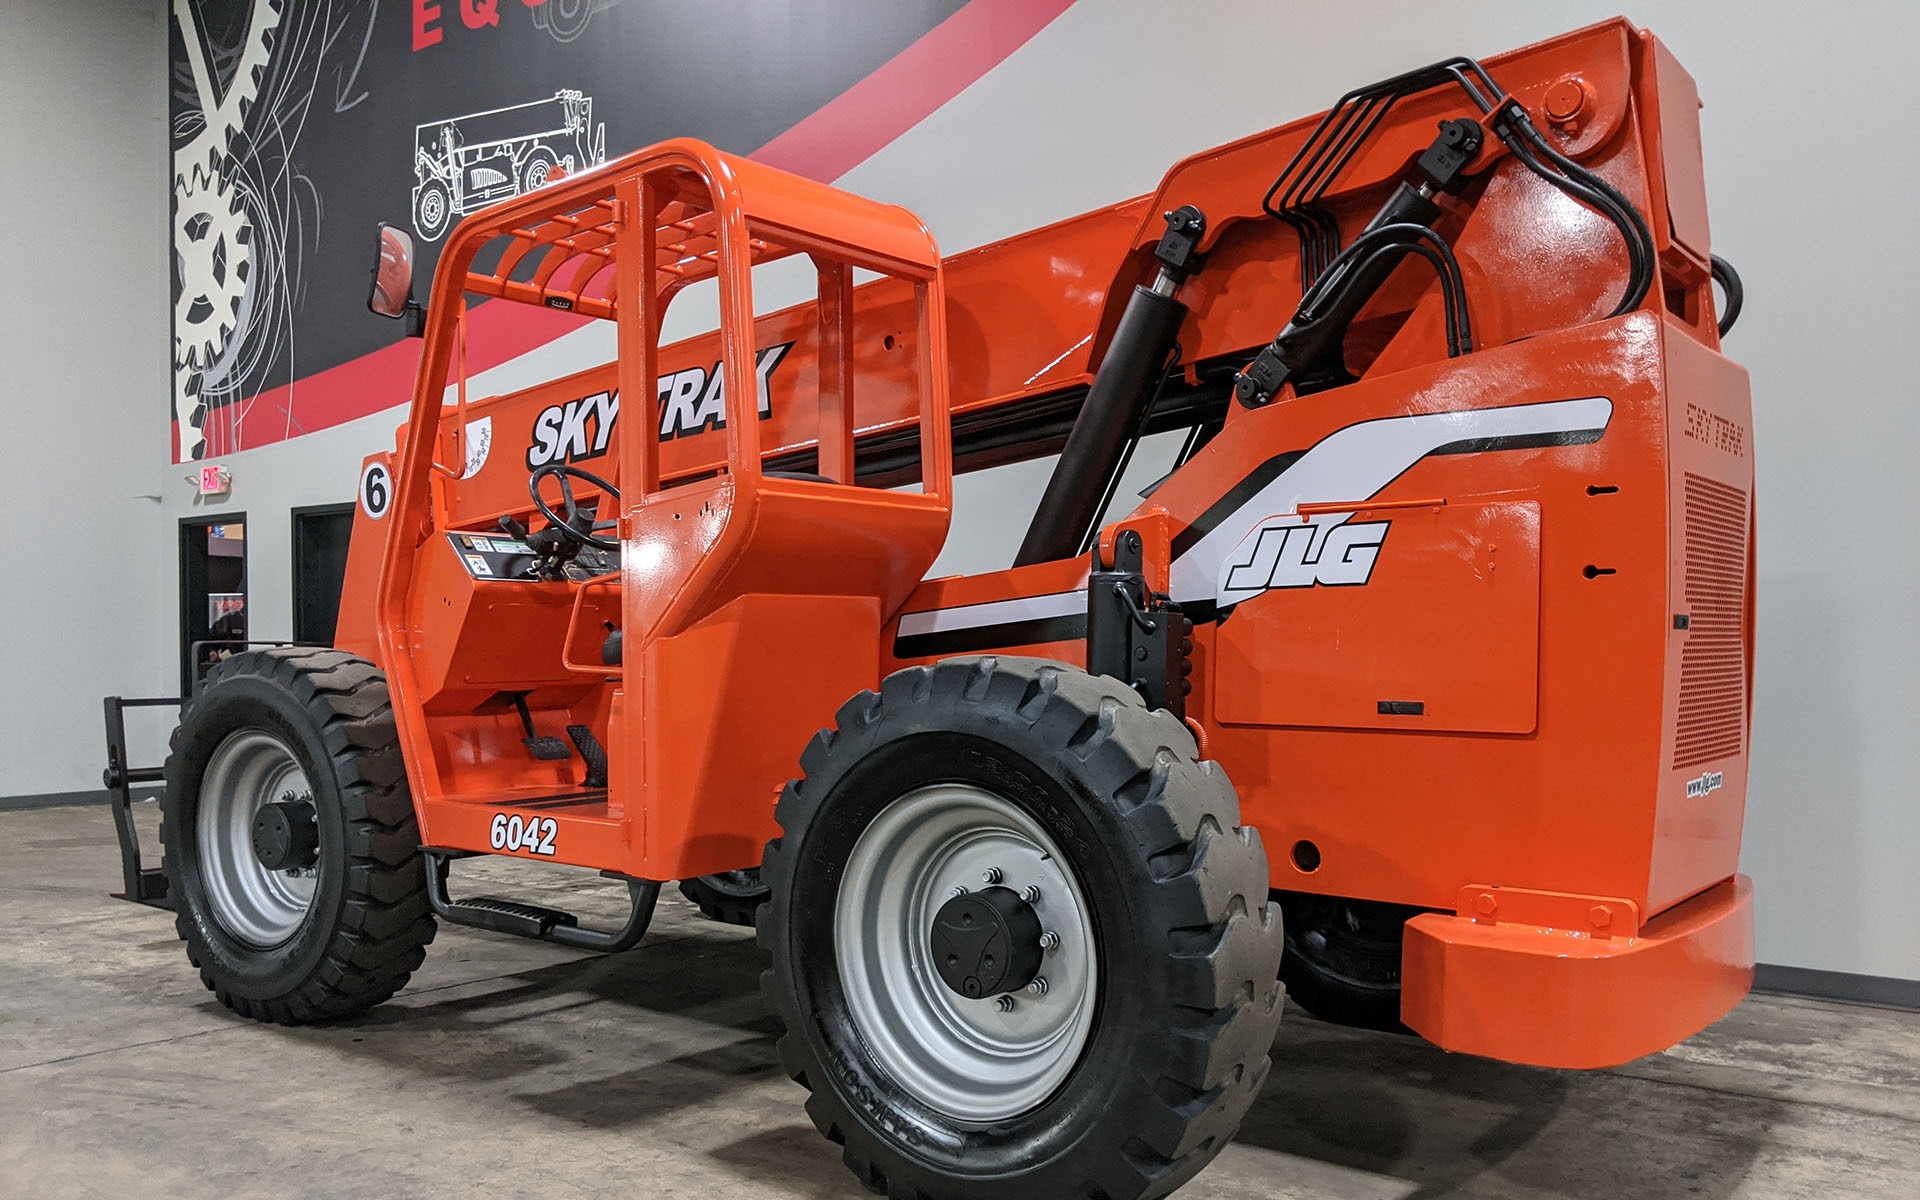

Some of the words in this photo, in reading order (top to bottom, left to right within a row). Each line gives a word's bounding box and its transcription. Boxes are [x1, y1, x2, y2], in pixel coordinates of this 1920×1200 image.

[412, 0, 548, 51] EQ
[366, 467, 386, 513] 6
[1224, 520, 1392, 591] JLG
[490, 812, 558, 857] 6042
